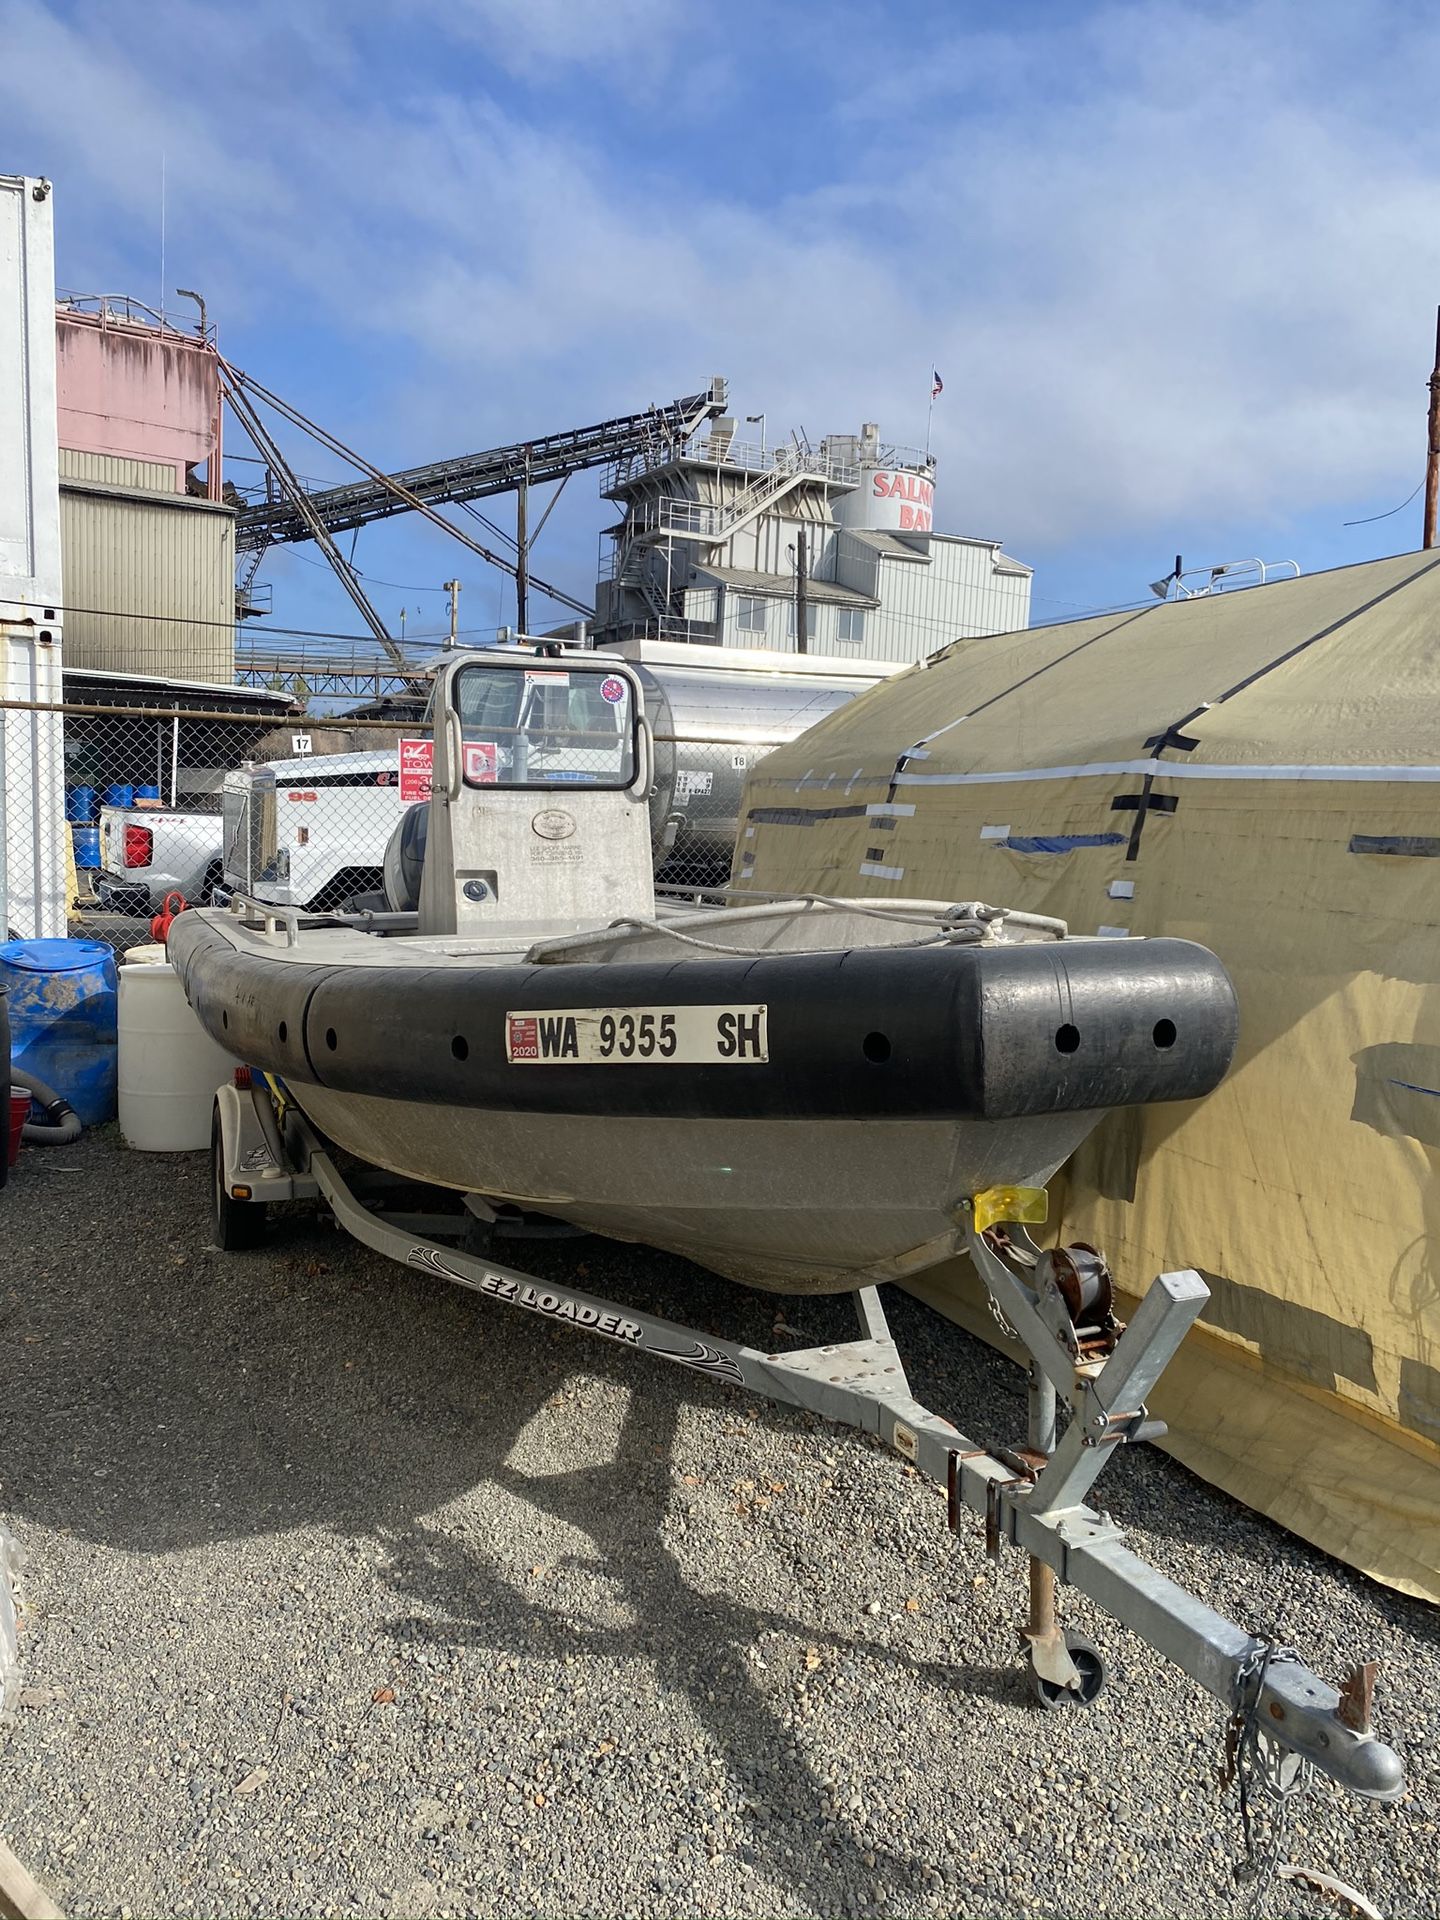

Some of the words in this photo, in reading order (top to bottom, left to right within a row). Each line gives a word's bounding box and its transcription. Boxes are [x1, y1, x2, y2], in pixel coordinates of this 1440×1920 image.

[296, 739, 309, 749] 17
[734, 757, 745, 766] 18
[539, 1016, 579, 1057] WA
[600, 1014, 677, 1057] 9355
[717, 1012, 761, 1058] SH
[512, 1046, 537, 1057] 2020
[479, 1272, 520, 1302] EZ
[519, 1284, 643, 1346] LOADER
